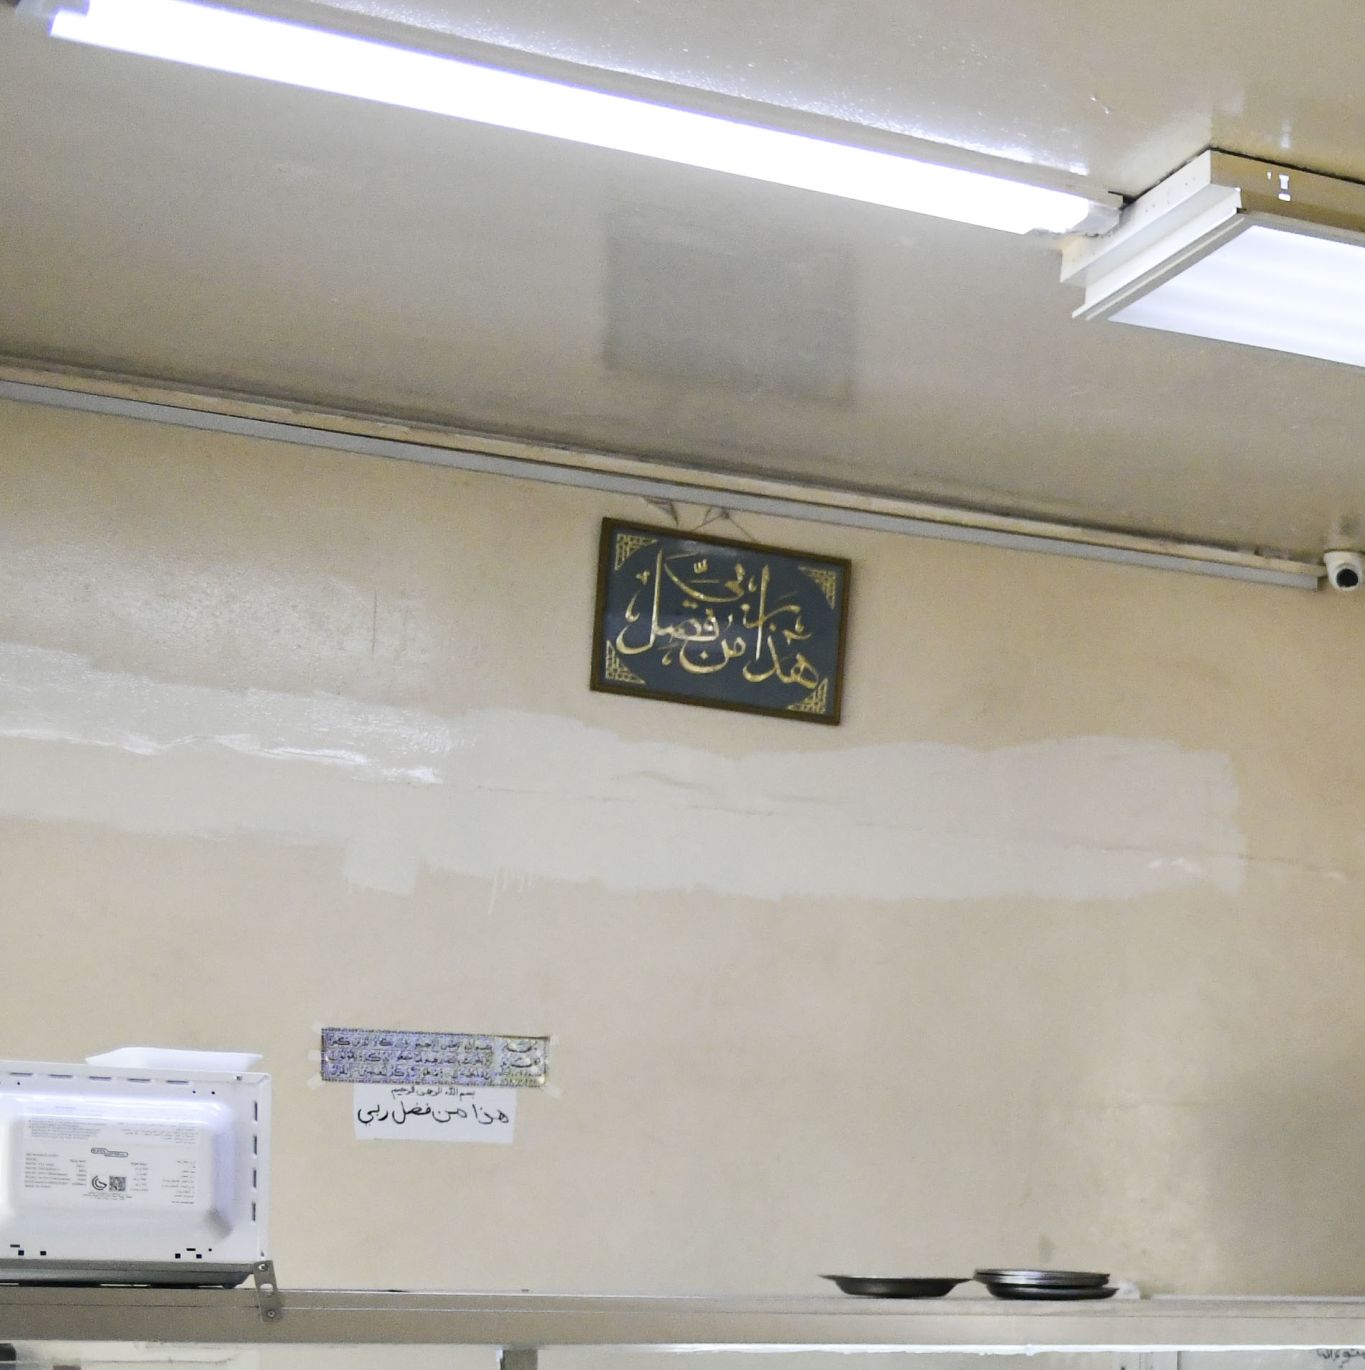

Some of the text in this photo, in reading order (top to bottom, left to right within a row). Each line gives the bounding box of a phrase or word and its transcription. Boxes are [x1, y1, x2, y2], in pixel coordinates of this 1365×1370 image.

[357, 1100, 509, 1126] هذا من فضل ربي
